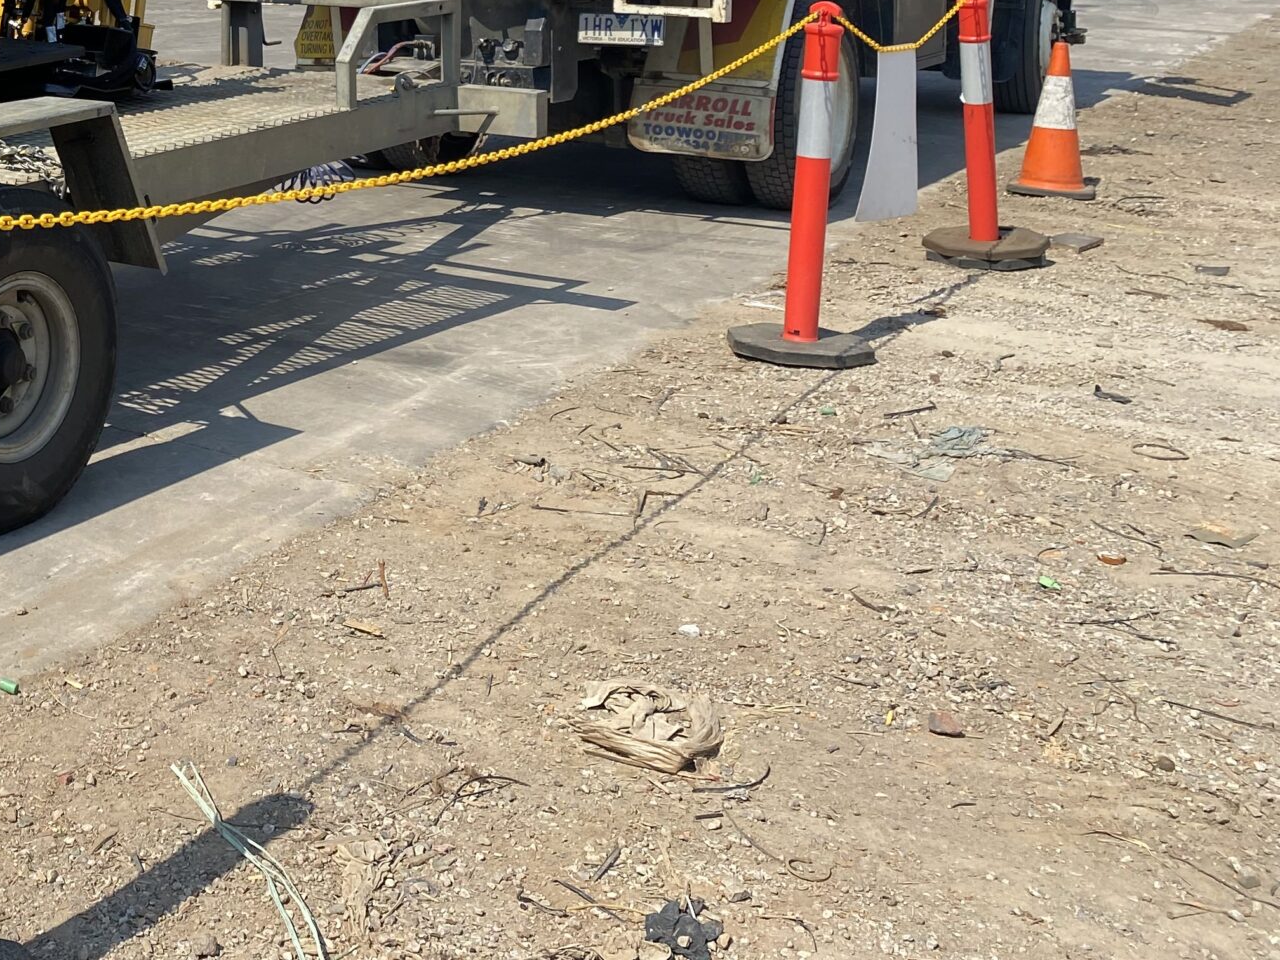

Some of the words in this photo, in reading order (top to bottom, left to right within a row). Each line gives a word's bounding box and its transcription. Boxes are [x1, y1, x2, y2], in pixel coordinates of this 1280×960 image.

[650, 91, 753, 117] RROLL
[703, 113, 756, 131] Sales
[643, 123, 761, 143] TOOWOO
